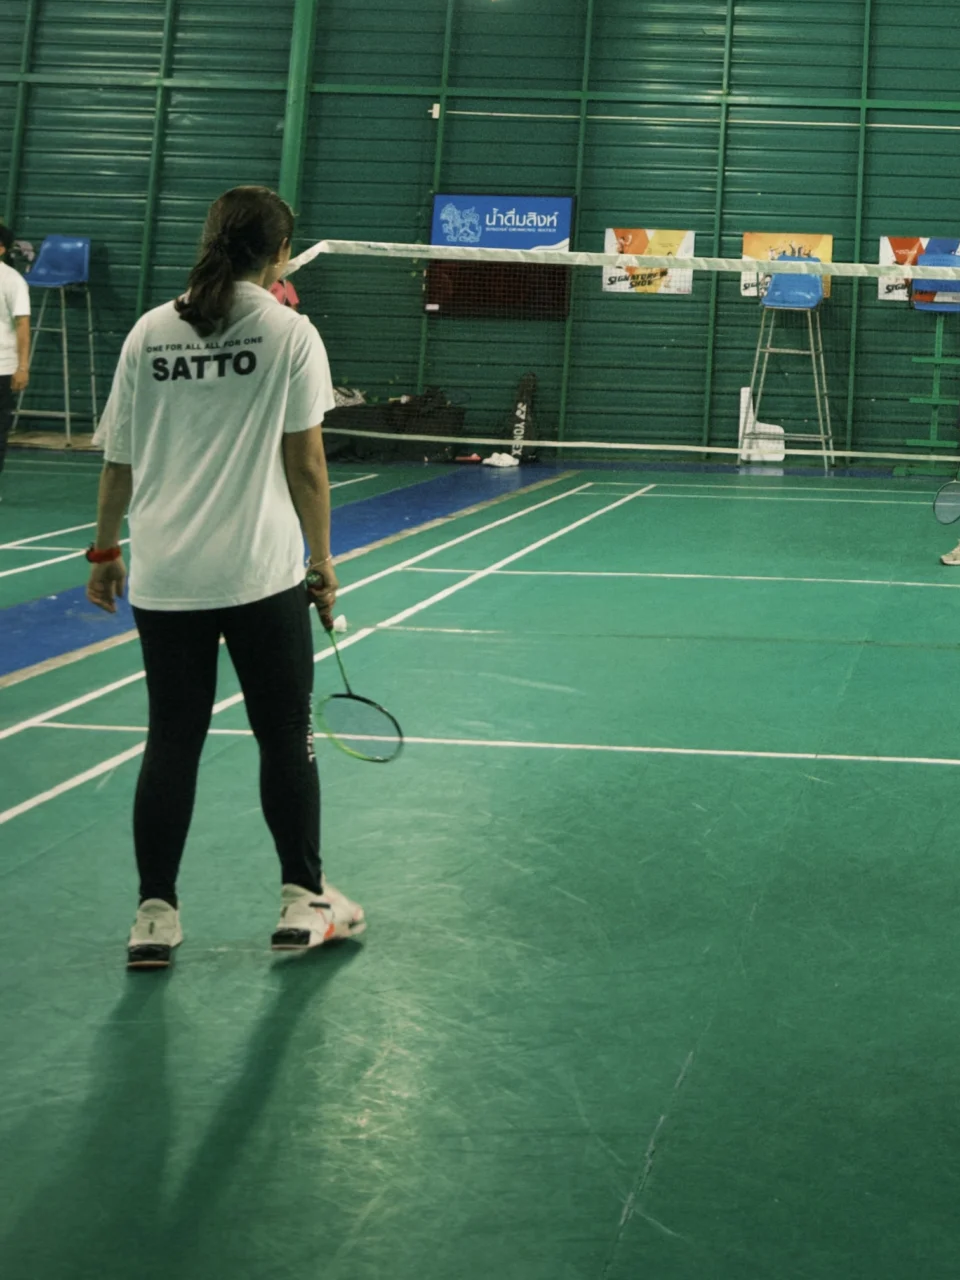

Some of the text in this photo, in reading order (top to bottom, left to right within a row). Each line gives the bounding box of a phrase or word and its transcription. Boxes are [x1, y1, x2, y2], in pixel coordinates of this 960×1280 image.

[485, 207, 560, 227] น้ำดื่มสิงห์
[146, 336, 263, 354] ONE FOR ALL ALL FOR ONE
[152, 350, 257, 381] SATTO
